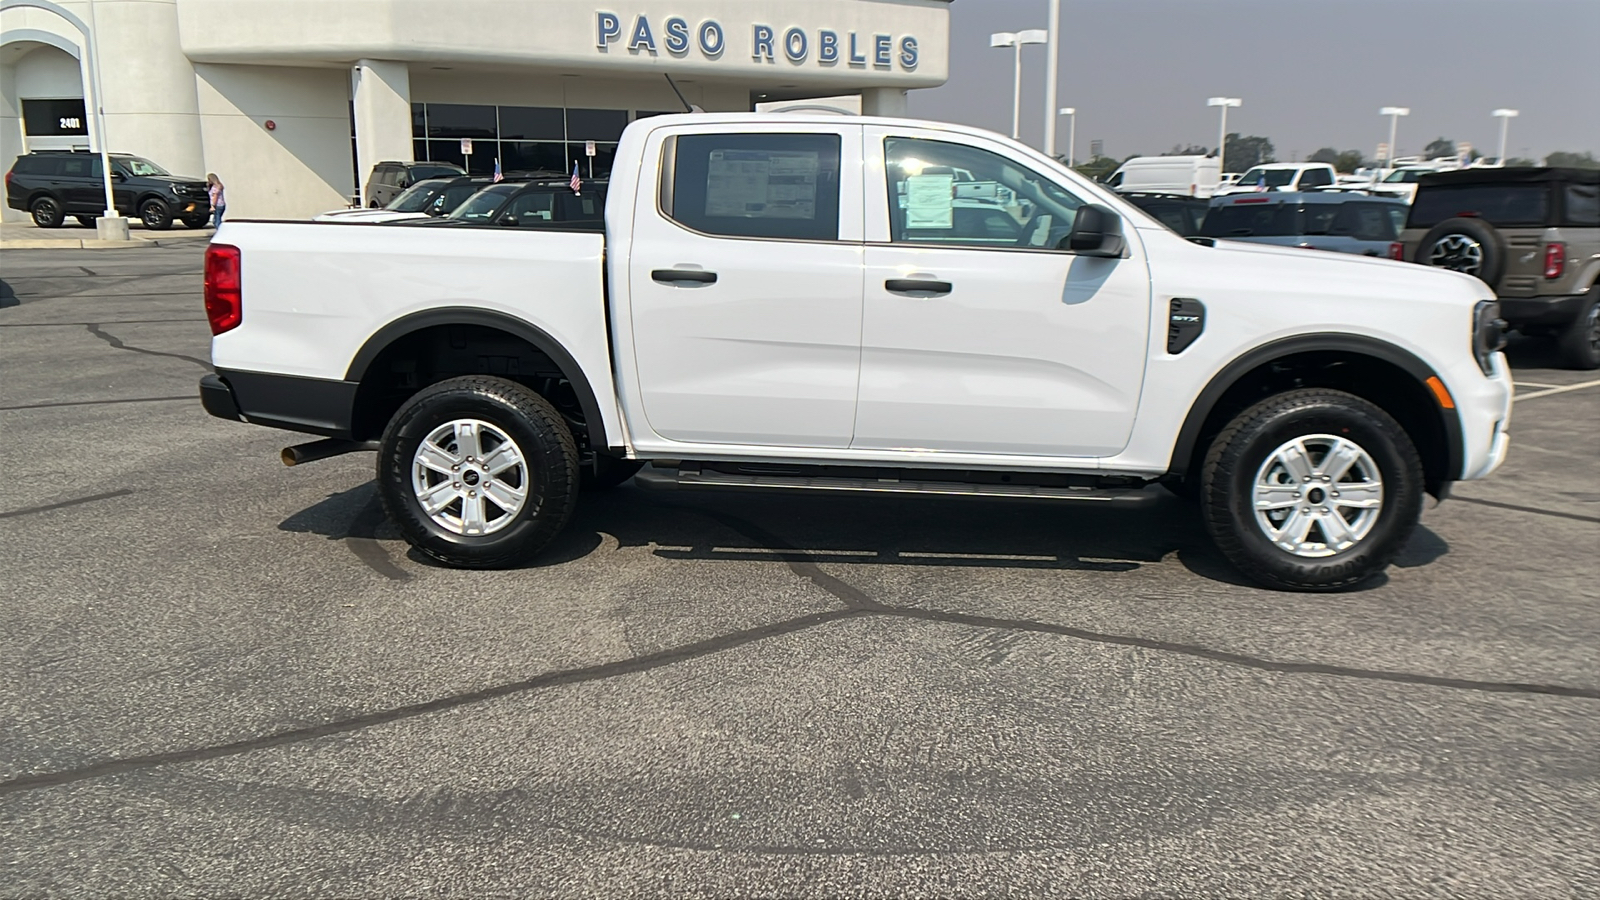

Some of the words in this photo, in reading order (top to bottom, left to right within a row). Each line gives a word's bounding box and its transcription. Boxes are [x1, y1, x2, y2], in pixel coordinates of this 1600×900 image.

[596, 11, 725, 56] PASO
[752, 24, 919, 68] ROBLES
[60, 117, 80, 128] 2401
